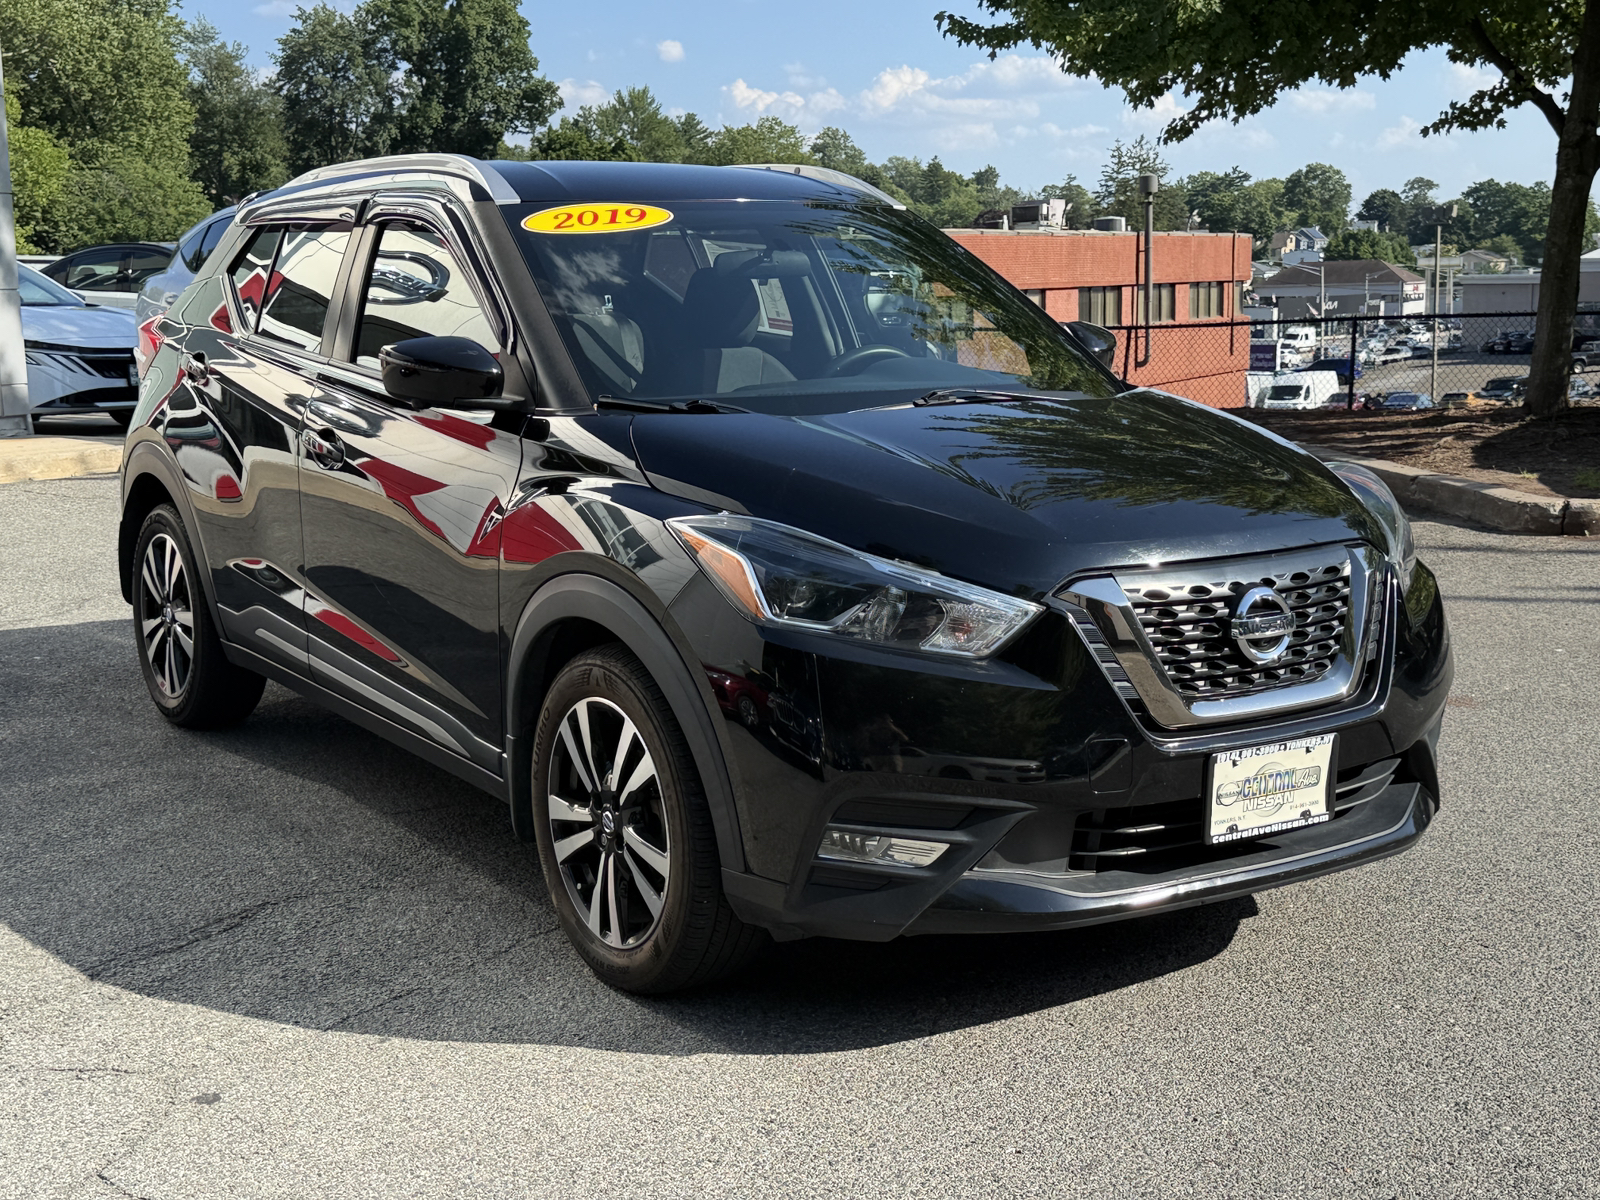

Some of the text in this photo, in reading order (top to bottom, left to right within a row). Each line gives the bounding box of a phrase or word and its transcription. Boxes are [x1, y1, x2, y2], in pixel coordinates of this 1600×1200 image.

[553, 207, 647, 230] 2019
[533, 706, 551, 783] KUMHO
[1241, 767, 1297, 799] CENTRAL
[1242, 790, 1296, 813] NISSAN
[1212, 813, 1330, 844] CentralAveNissan.com
